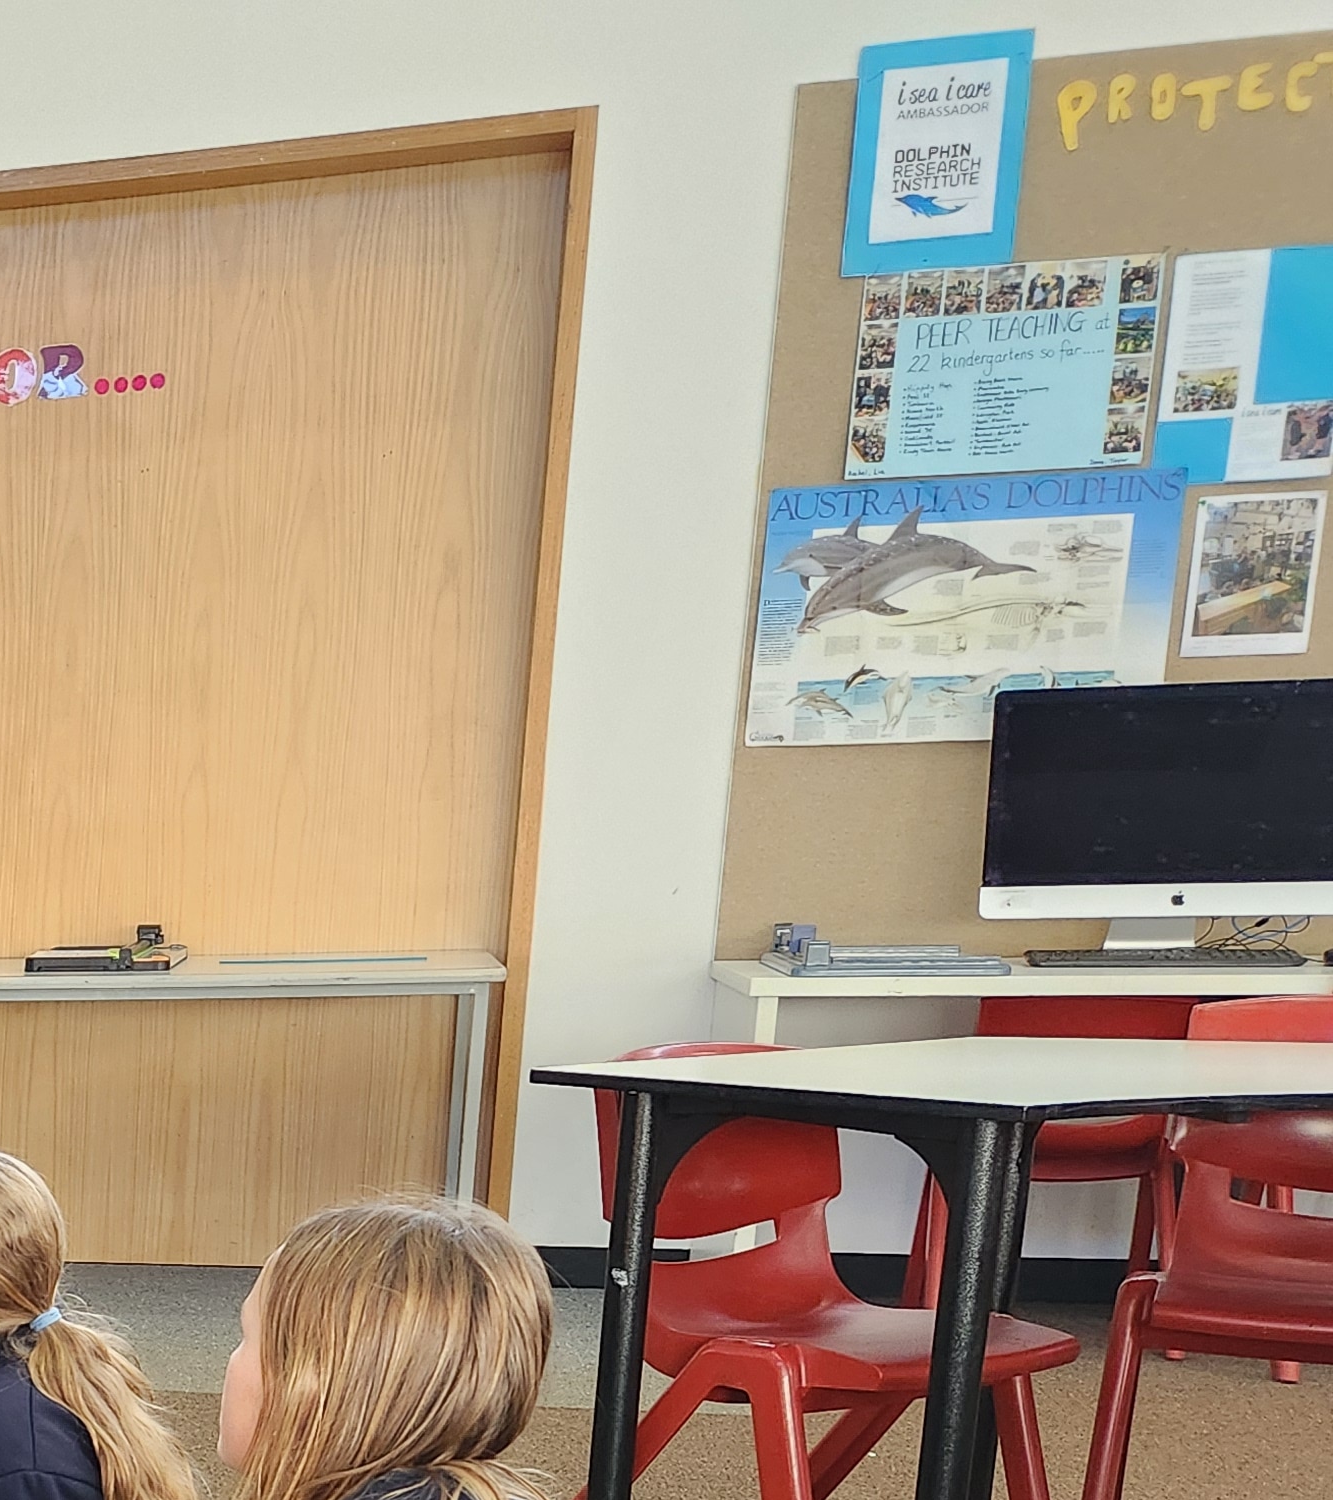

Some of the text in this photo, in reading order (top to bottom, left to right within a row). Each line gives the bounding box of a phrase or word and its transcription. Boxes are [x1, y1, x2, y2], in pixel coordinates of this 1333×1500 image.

[898, 76, 992, 105] i sea i care
[896, 102, 990, 120] AMBASSADOR
[894, 142, 972, 164] DOLPHIN
[893, 157, 982, 178] RESEARCH
[891, 171, 980, 193] INSTITUTE
[915, 310, 1111, 350] PEER TEACHING at
[906, 354, 931, 373] 22
[941, 349, 1035, 376] kindergartens
[1040, 346, 1055, 359] so
[770, 473, 1182, 521] AUSTRALIA'S DOLPHINS
